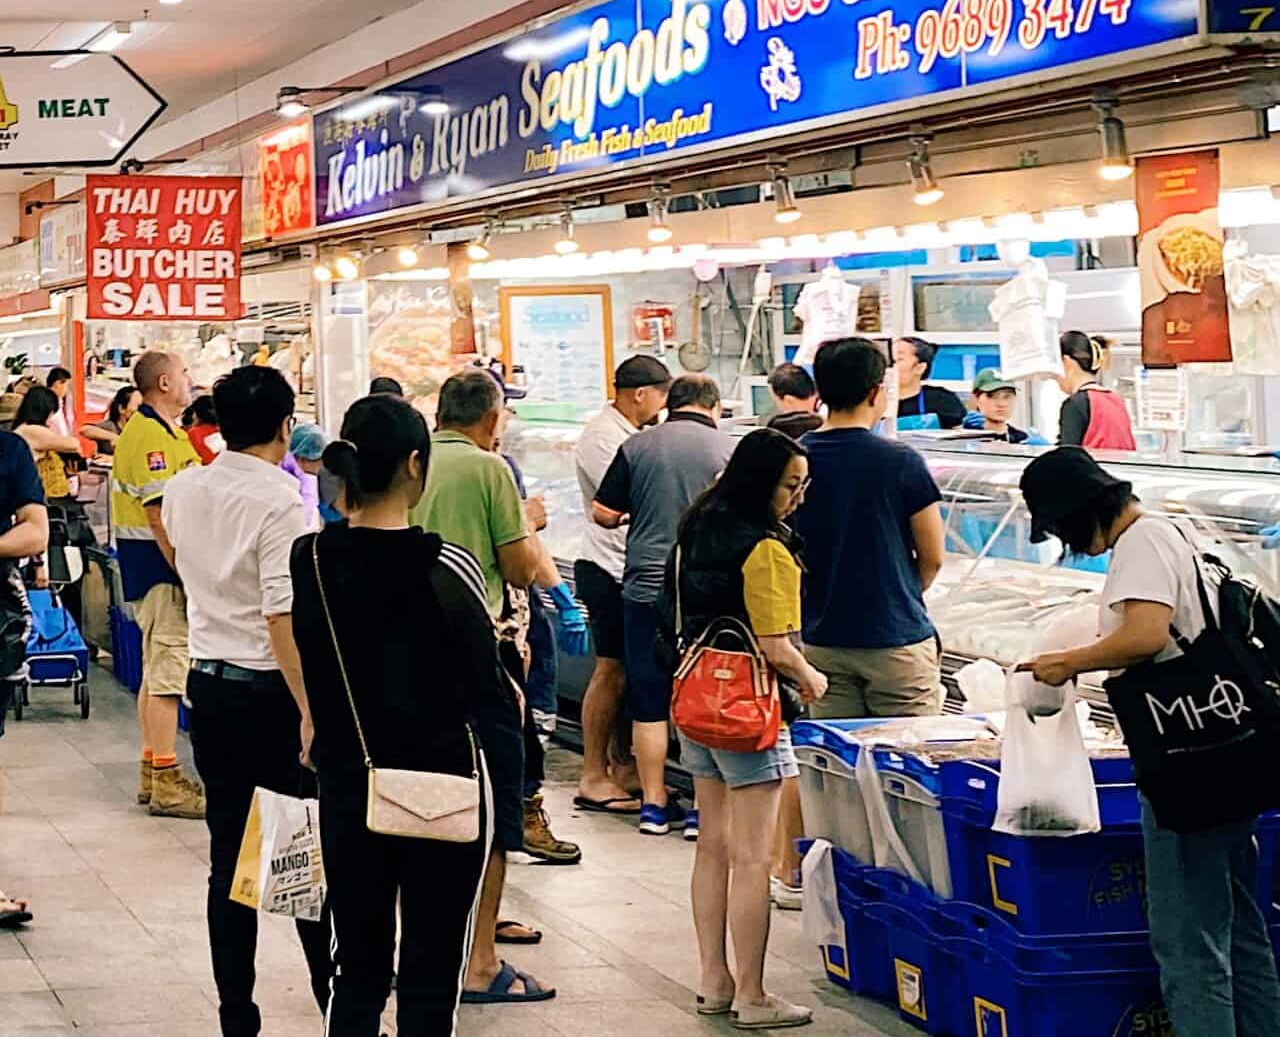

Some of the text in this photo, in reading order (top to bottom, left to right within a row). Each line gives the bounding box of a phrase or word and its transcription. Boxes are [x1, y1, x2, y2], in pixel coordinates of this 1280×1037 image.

[38, 97, 111, 119] MEAT
[644, 103, 713, 148] Seafood
[325, 128, 404, 217] Kelvin
[429, 94, 509, 180] Ryan
[92, 188, 237, 215] THAI HUY
[92, 248, 236, 280] BUTCHER
[102, 283, 226, 317] SALE
[271, 851, 309, 876] MANGO
